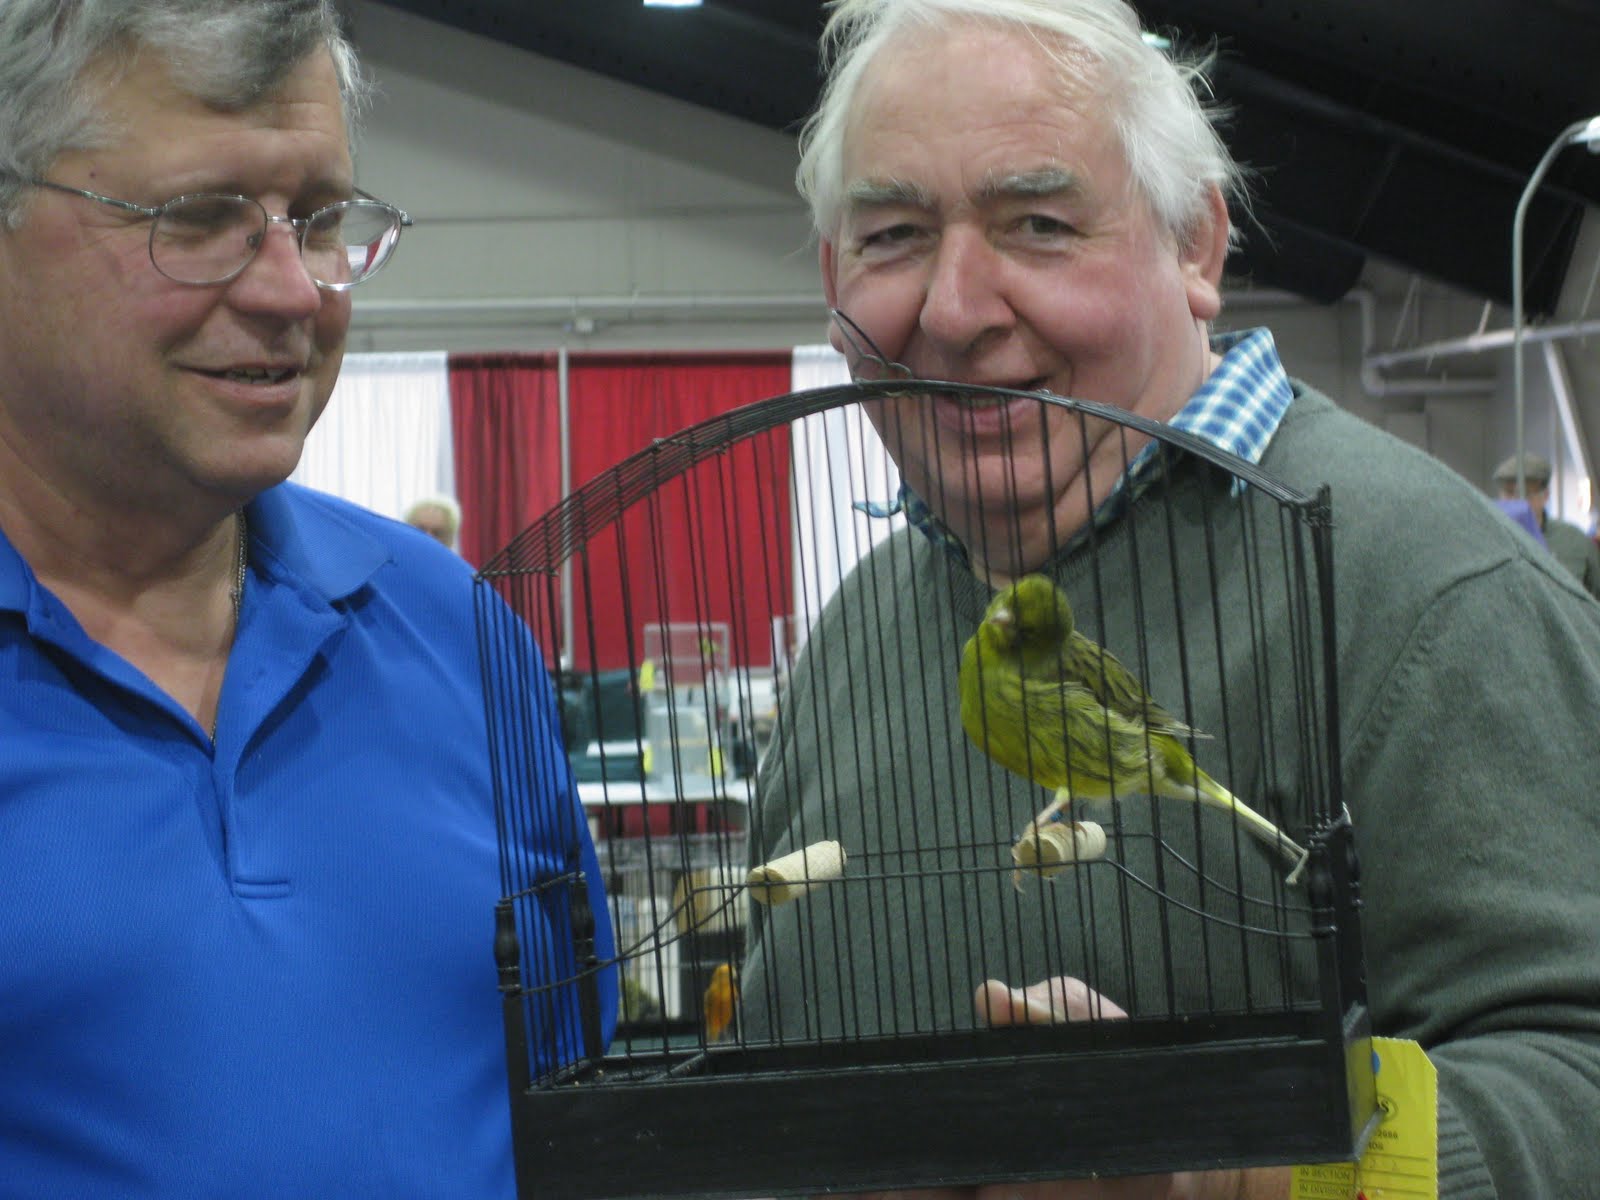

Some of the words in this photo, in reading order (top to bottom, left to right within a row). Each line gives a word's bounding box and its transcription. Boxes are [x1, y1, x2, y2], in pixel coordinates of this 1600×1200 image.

[1299, 1168, 1309, 1176] IN
[1299, 1184, 1308, 1192] IN
[1310, 1184, 1349, 1196] DIVISION
